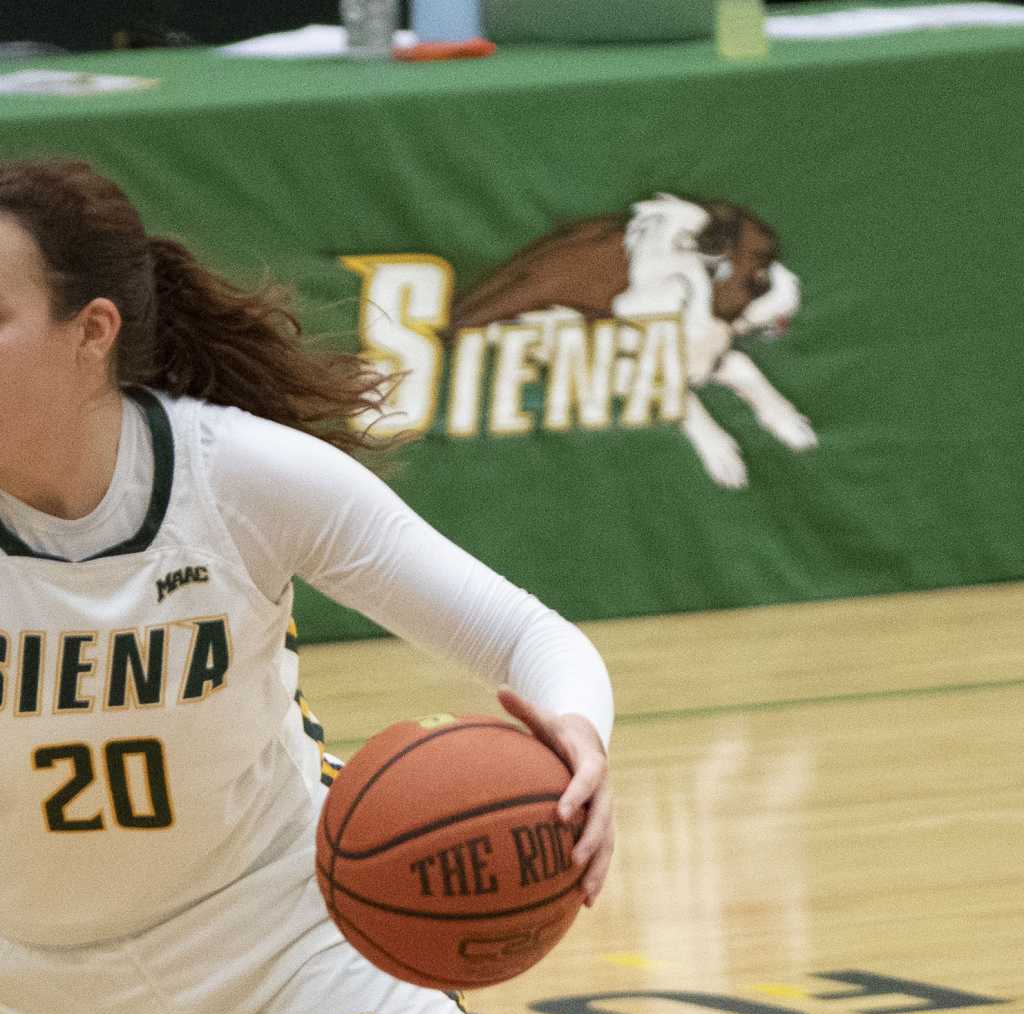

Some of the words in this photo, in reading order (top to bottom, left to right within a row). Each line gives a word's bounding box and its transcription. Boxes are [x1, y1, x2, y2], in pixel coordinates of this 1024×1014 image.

[340, 253, 689, 440] SIENA
[156, 565, 209, 602] MAAC
[31, 734, 173, 832] 20
[410, 834, 499, 897] THE
